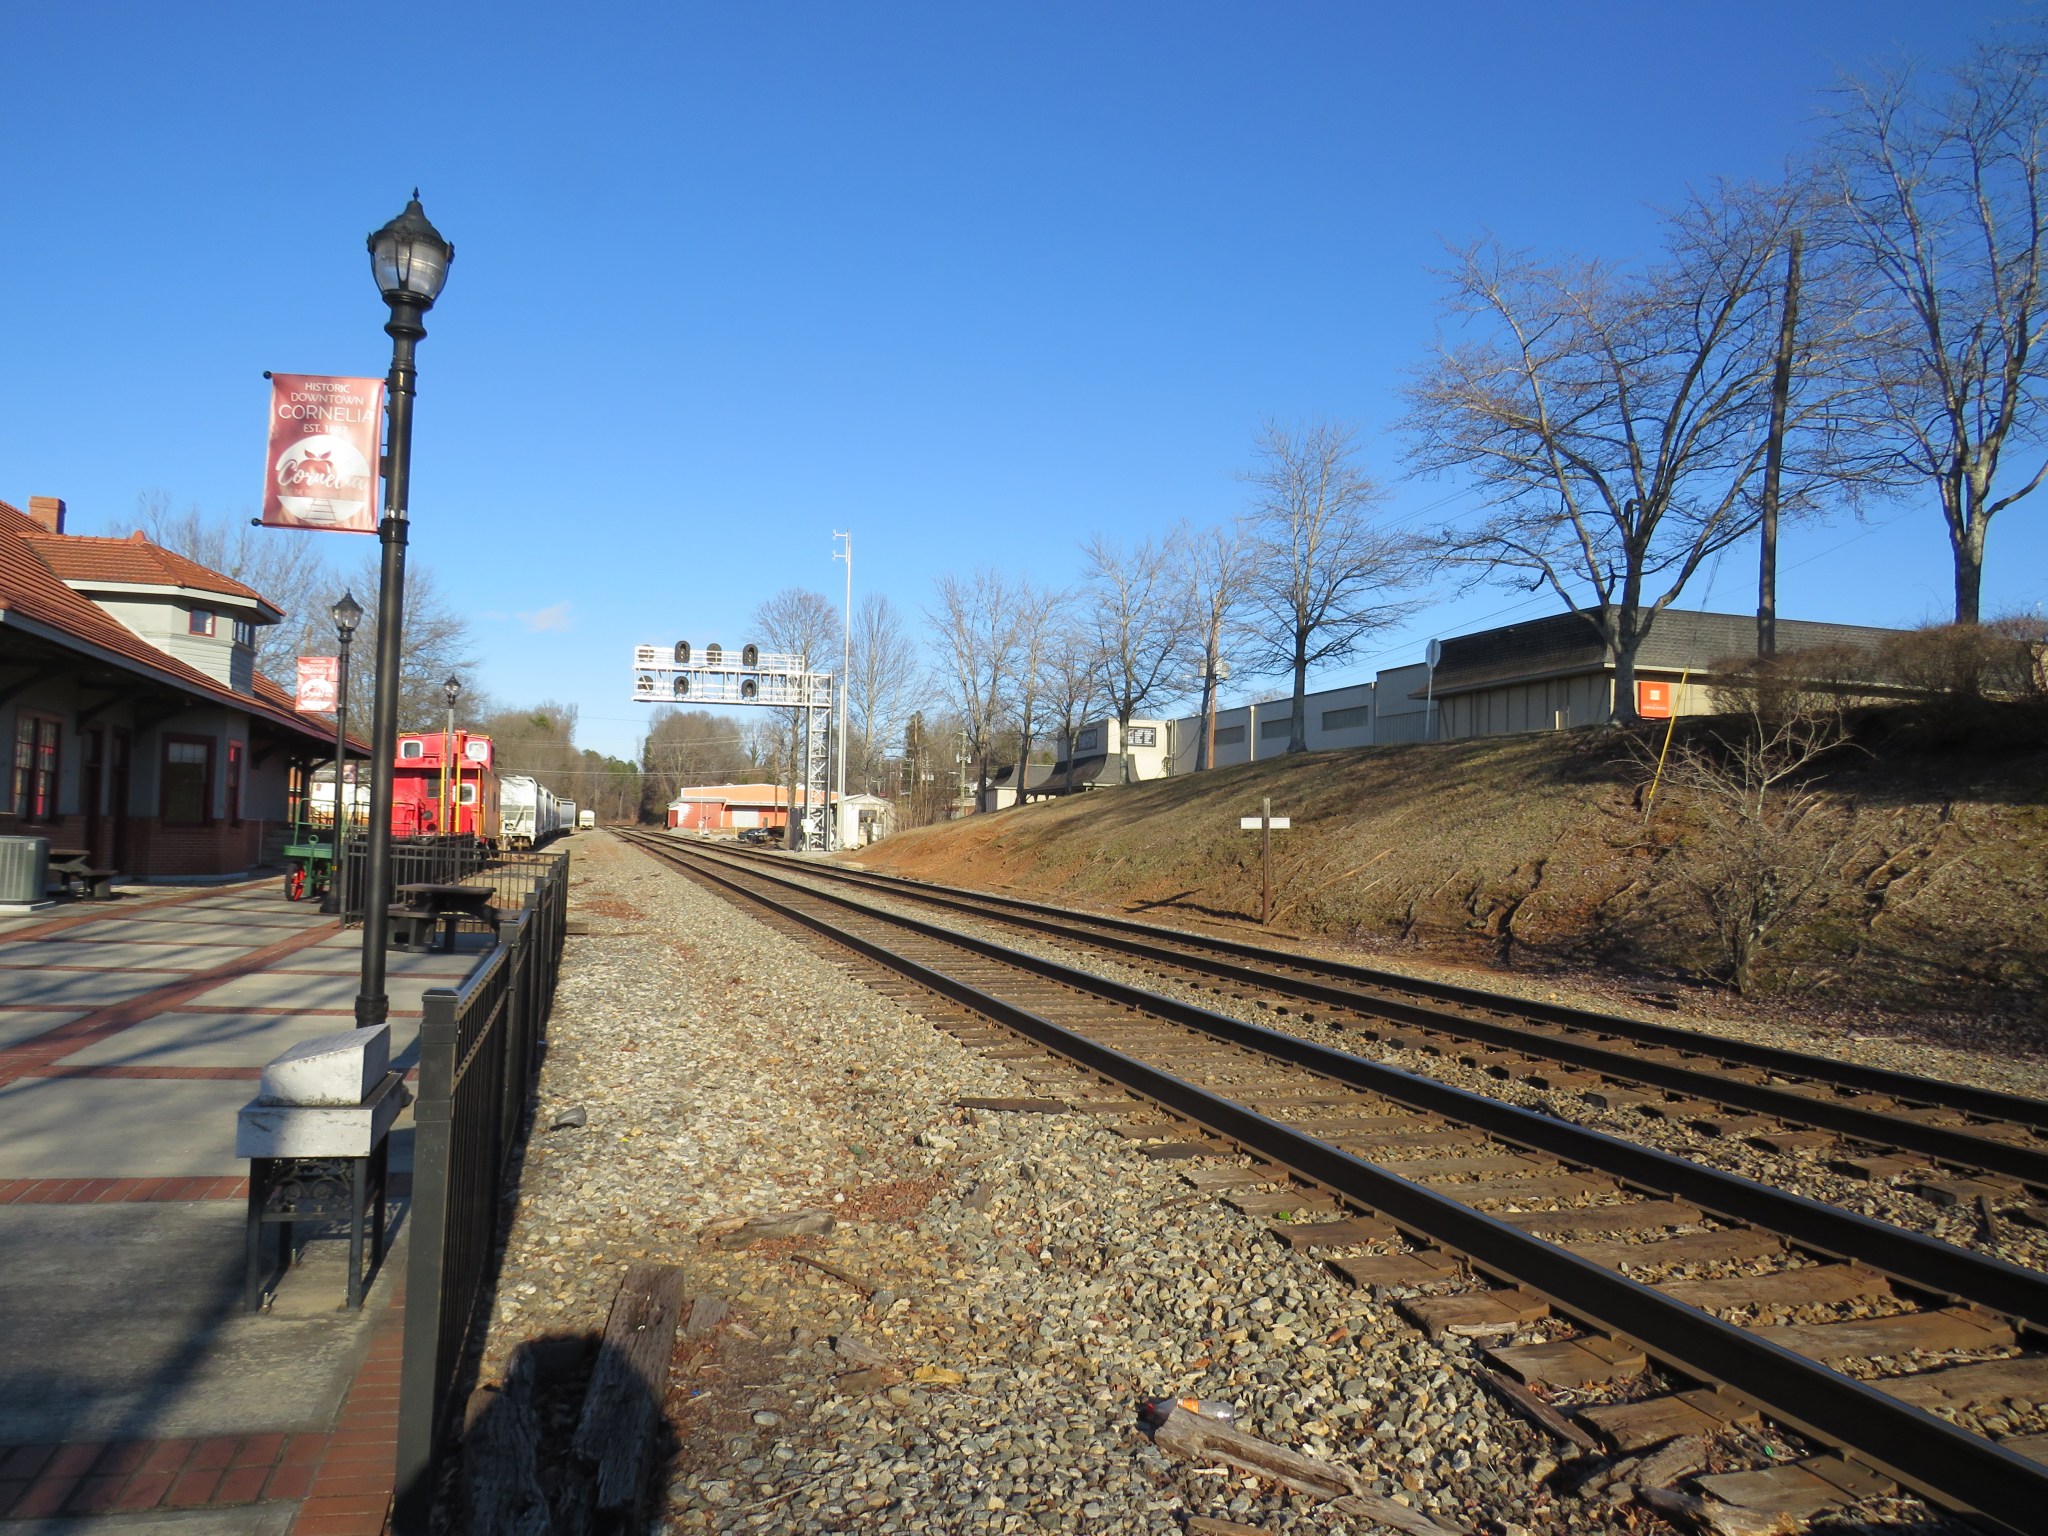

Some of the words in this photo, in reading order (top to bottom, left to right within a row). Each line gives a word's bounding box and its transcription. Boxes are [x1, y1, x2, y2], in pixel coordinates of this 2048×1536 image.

[305, 382, 350, 393] HISTORIC
[291, 392, 363, 405] DOWNTOWN
[278, 405, 374, 423] CORNELIA
[303, 423, 322, 433] EST.
